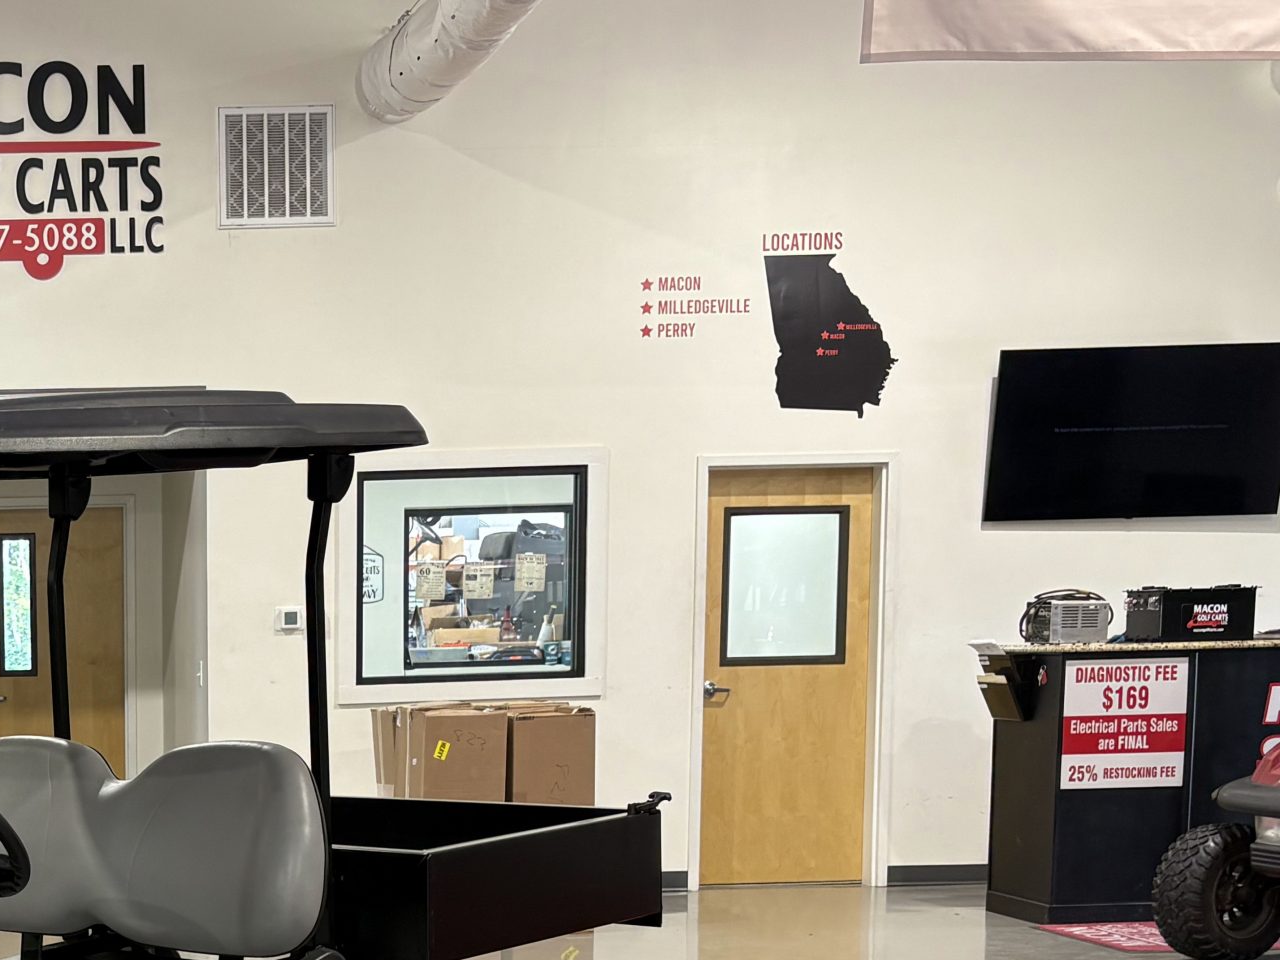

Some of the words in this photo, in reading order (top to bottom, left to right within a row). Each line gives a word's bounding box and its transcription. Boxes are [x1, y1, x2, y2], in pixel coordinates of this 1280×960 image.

[15, 155, 164, 214] CARTS
[109, 215, 164, 254] LLC
[762, 231, 844, 252] LOCATIONS
[658, 276, 701, 292] MACON
[657, 298, 751, 315] MILLEDGEVILLE
[657, 322, 696, 338] PERRY
[1193, 603, 1228, 613] MACON
[1075, 665, 1151, 683] DIAGNOSTIC
[1155, 664, 1178, 681] FEE
[1102, 685, 1150, 712] $169
[1070, 719, 1118, 734] Electrical
[1120, 718, 1147, 733] Parts
[1150, 717, 1178, 732] Sales
[1098, 738, 1115, 750] are
[1118, 735, 1149, 749] FINAL
[1068, 764, 1098, 782] 25%
[1103, 766, 1157, 779] RESTOCKING
[1160, 766, 1177, 778] FEE
